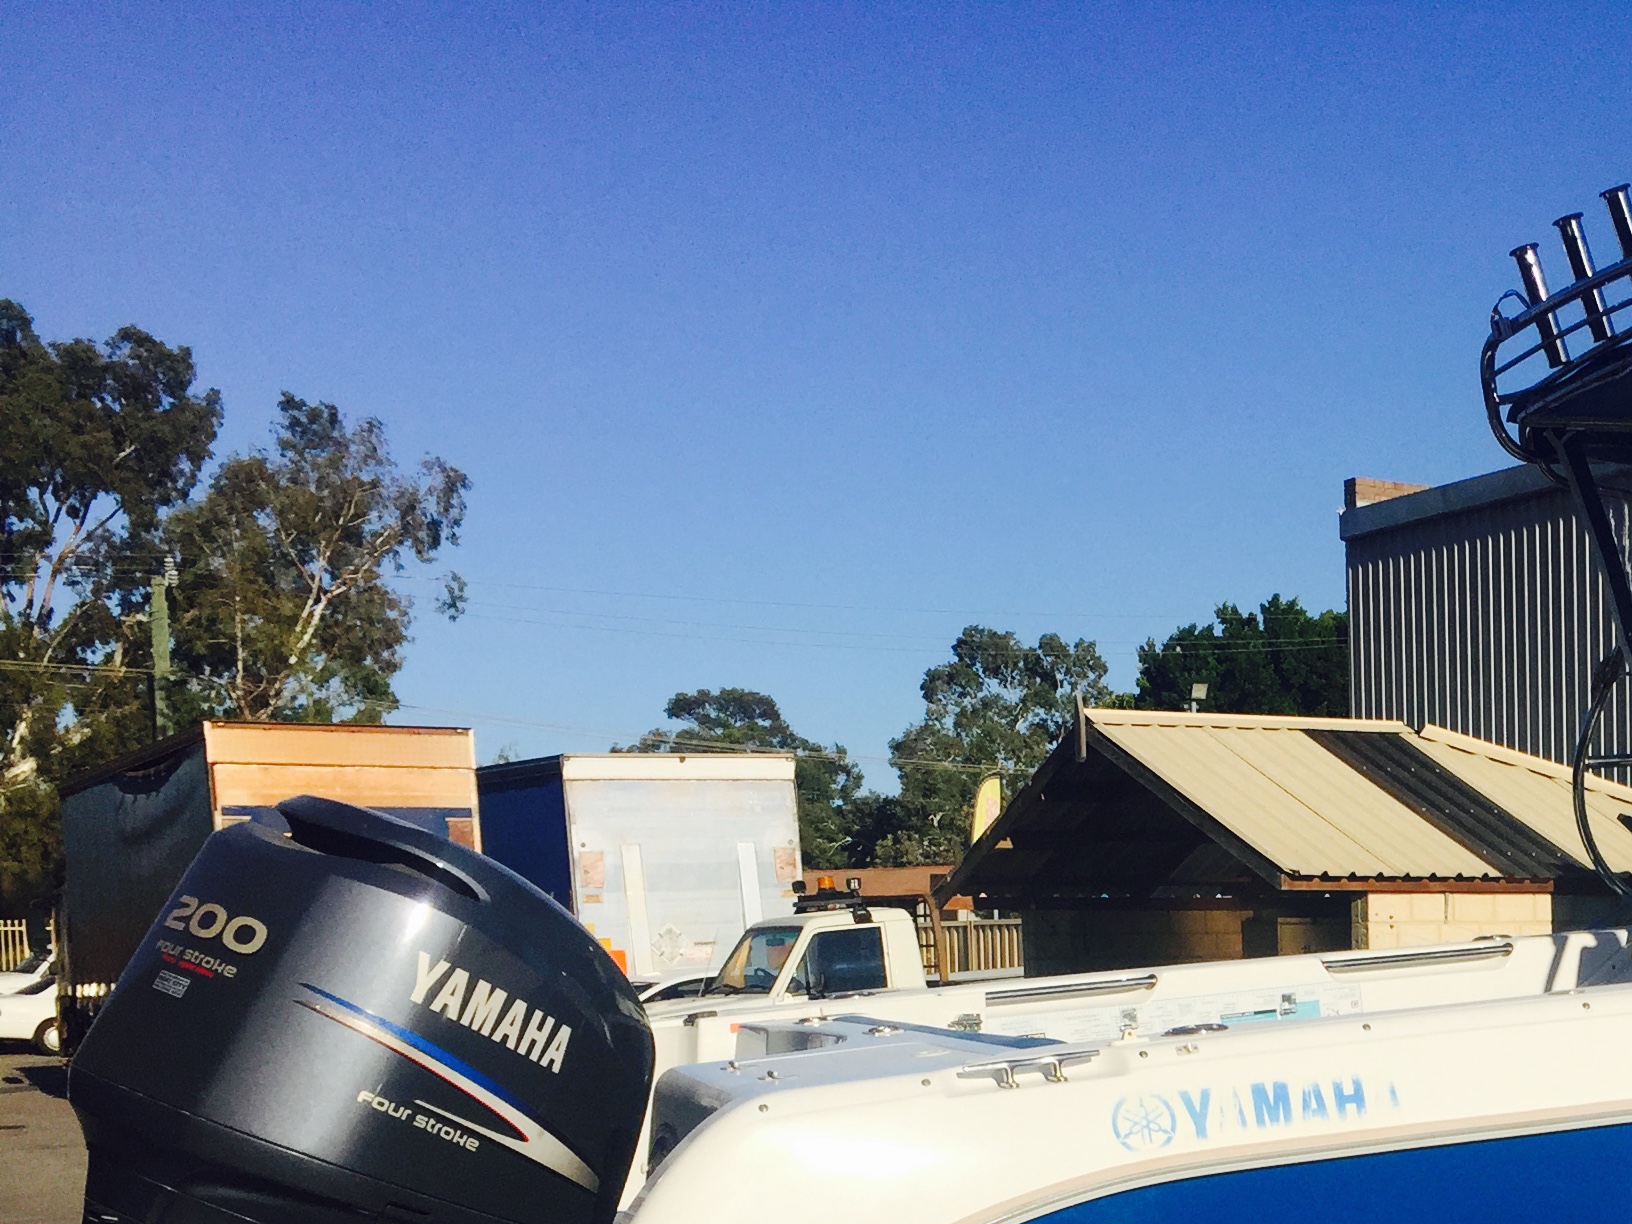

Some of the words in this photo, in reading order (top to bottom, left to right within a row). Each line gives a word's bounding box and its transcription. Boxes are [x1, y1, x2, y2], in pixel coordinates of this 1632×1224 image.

[164, 894, 268, 955] 200
[409, 950, 572, 1074] YAMAHA
[1178, 1075, 1399, 1140] YMAH
